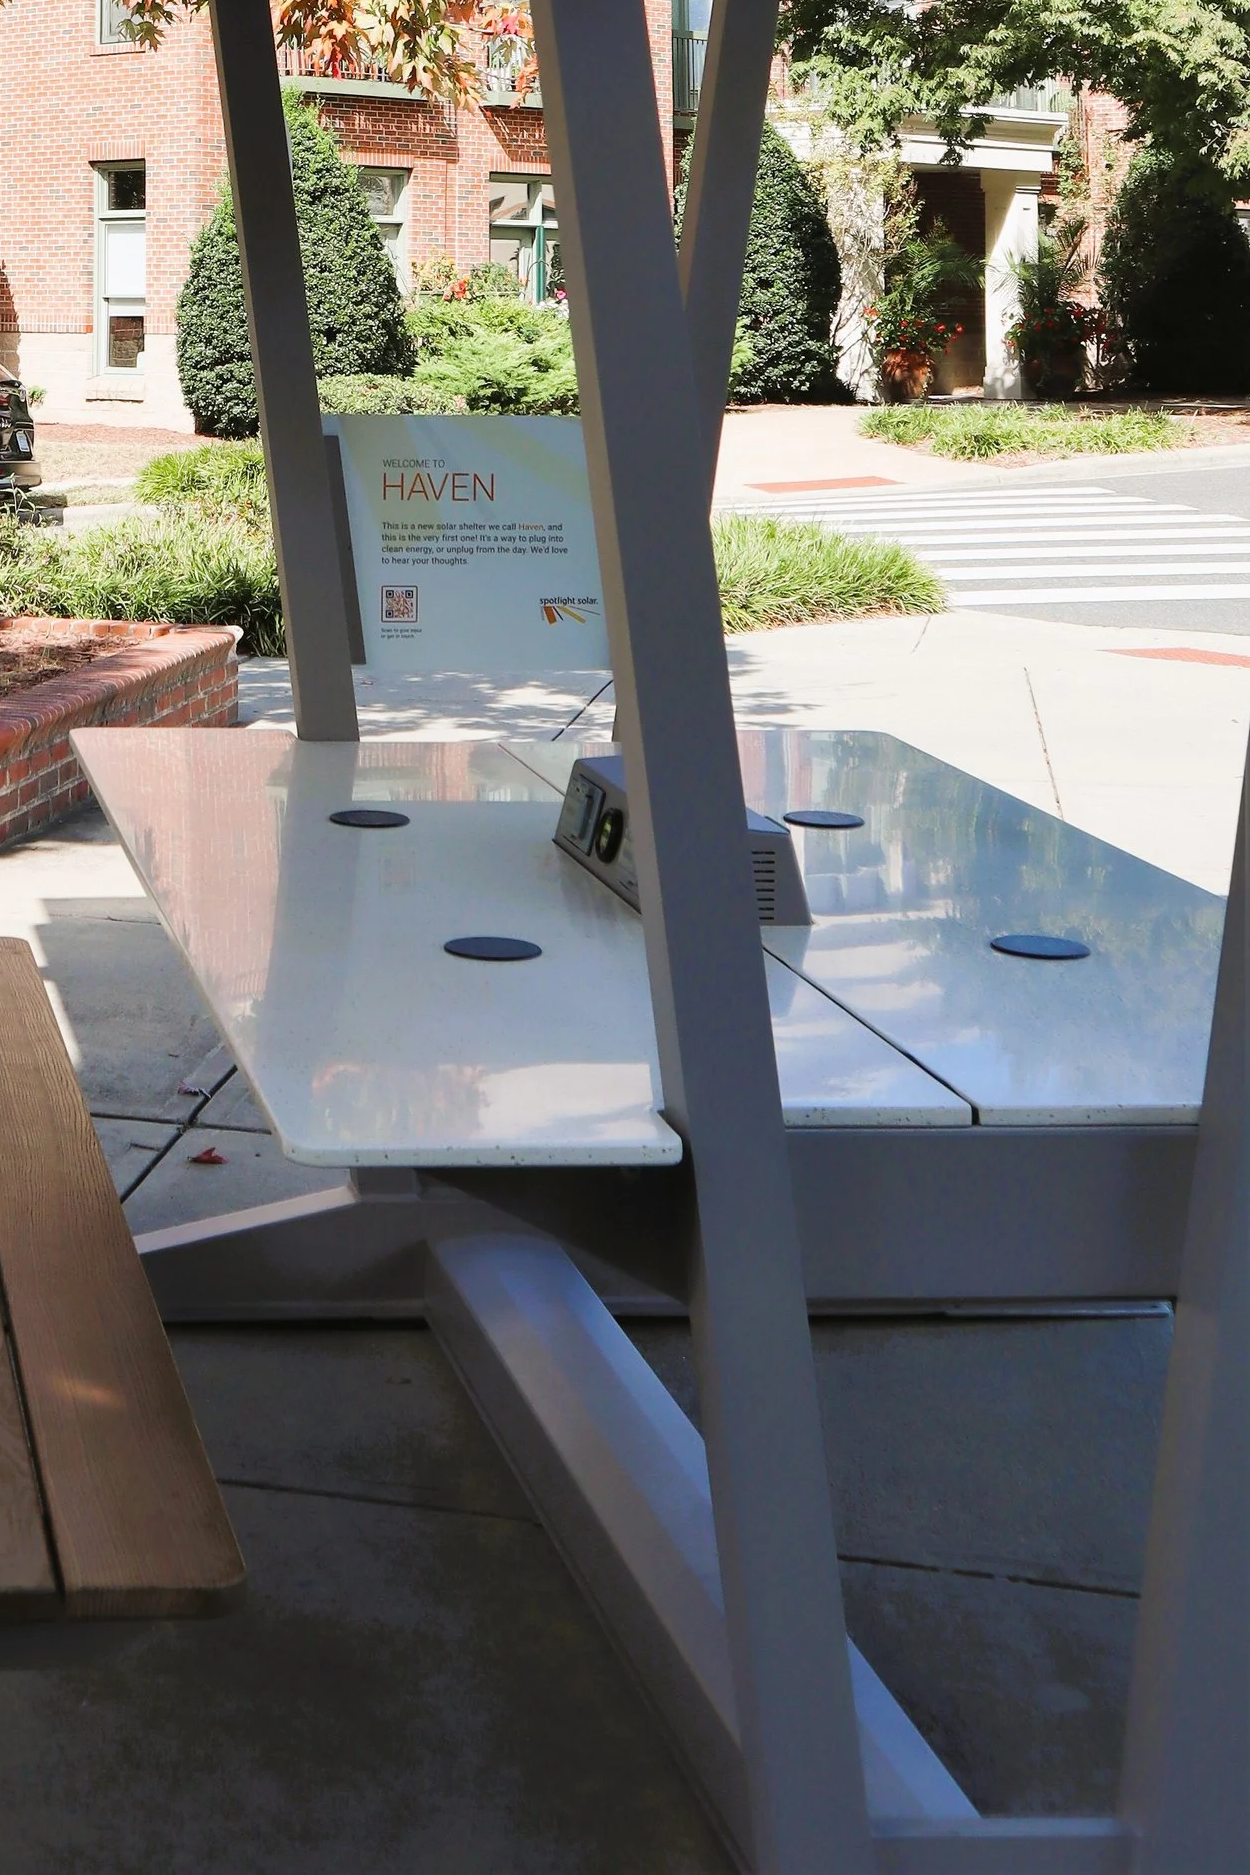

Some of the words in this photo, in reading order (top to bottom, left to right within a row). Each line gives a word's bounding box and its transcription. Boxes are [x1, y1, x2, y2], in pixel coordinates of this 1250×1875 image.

[383, 459, 431, 468] WELCOME
[433, 460, 446, 468] TO
[383, 473, 495, 501] HAVEN
[382, 522, 399, 530] This
[459, 523, 486, 531] shelter
[502, 523, 517, 531] call
[518, 524, 546, 532] Haven,
[423, 535, 440, 544] very
[442, 534, 458, 542] first
[460, 534, 478, 542] one!
[479, 534, 492, 542] It's
[500, 536, 517, 544] way
[528, 534, 547, 544] plug
[381, 545, 404, 553] clean
[405, 547, 434, 555] energy,
[446, 546, 474, 555] unplug
[530, 546, 550, 554] We'd
[551, 546, 568, 554] love
[411, 558, 429, 567] your
[539, 597, 576, 606] spotlight
